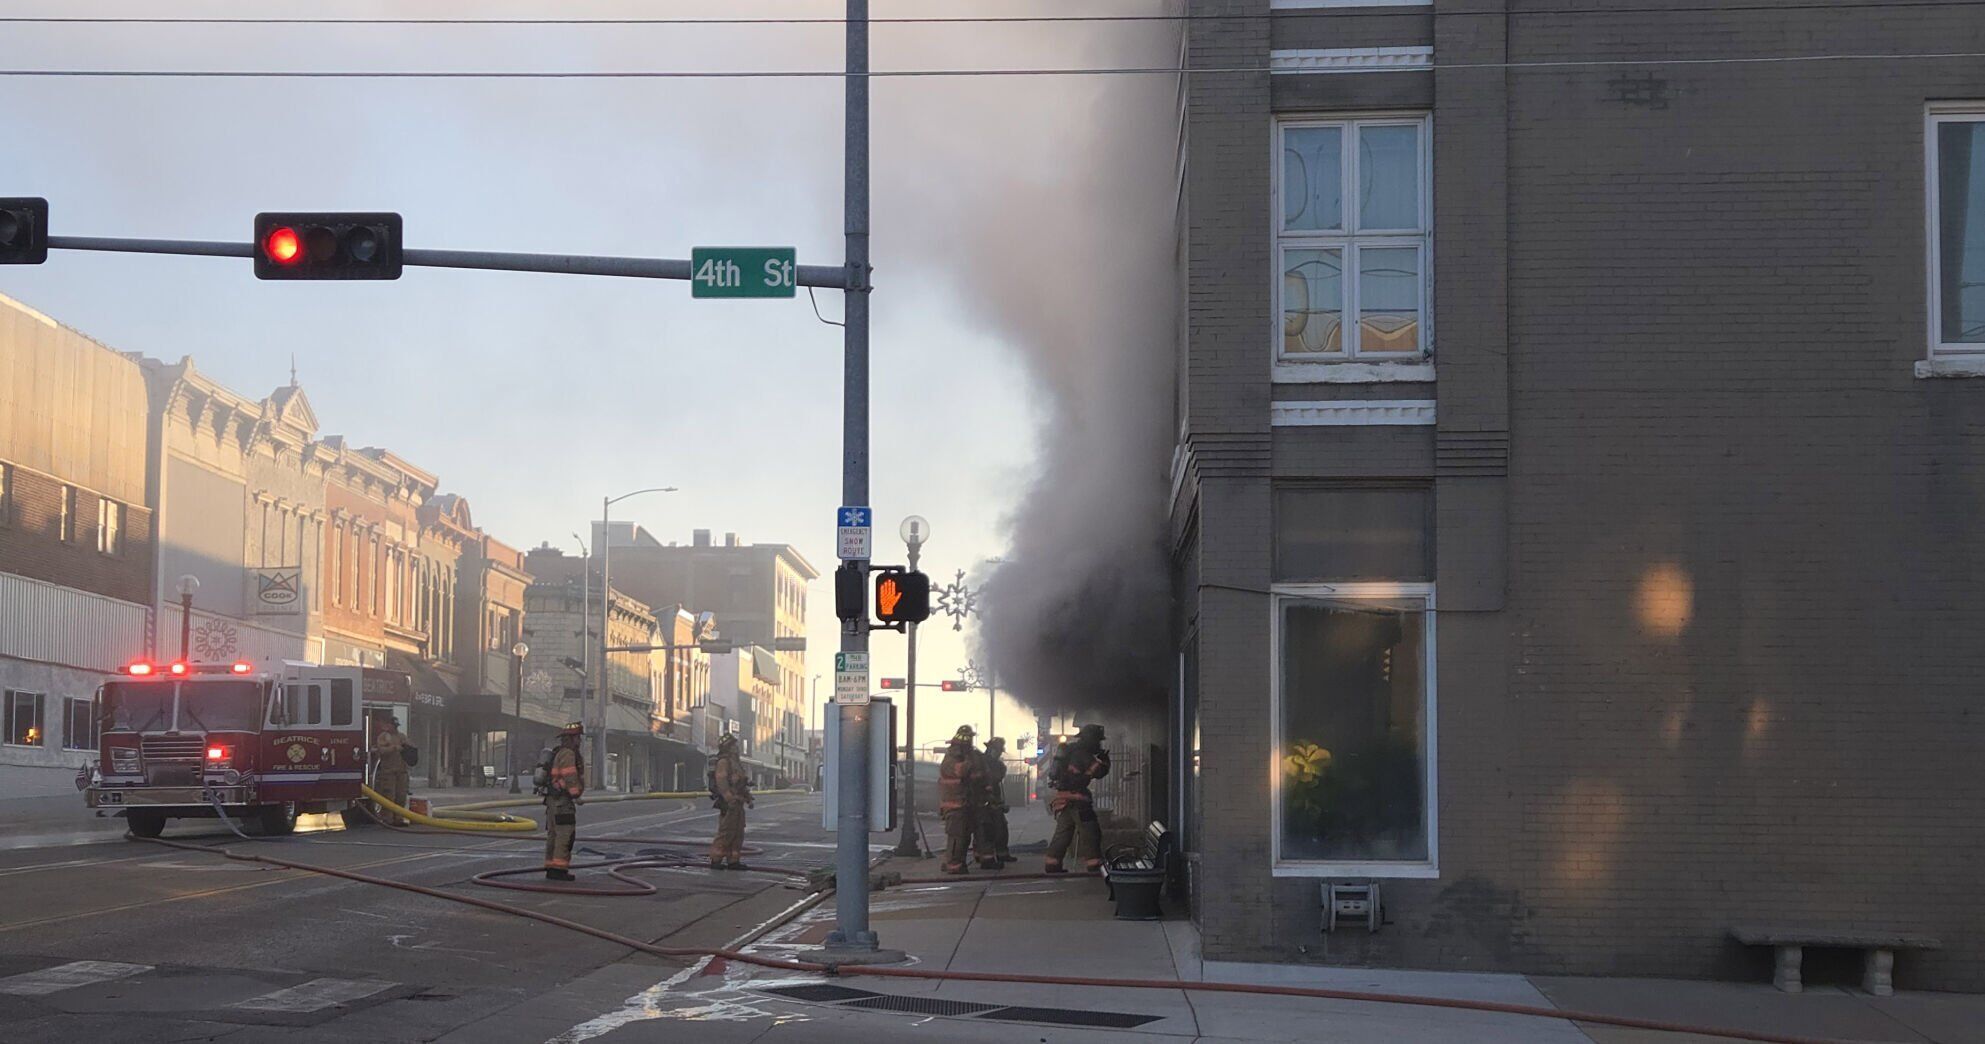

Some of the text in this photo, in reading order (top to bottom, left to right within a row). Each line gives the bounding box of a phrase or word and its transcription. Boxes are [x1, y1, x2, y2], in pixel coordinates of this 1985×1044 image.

[695, 258, 793, 287] 4th St
[843, 547, 865, 555] ROUTE
[263, 592, 293, 600] COOK
[836, 656, 844, 669] 2
[273, 735, 320, 746] BEATRICE
